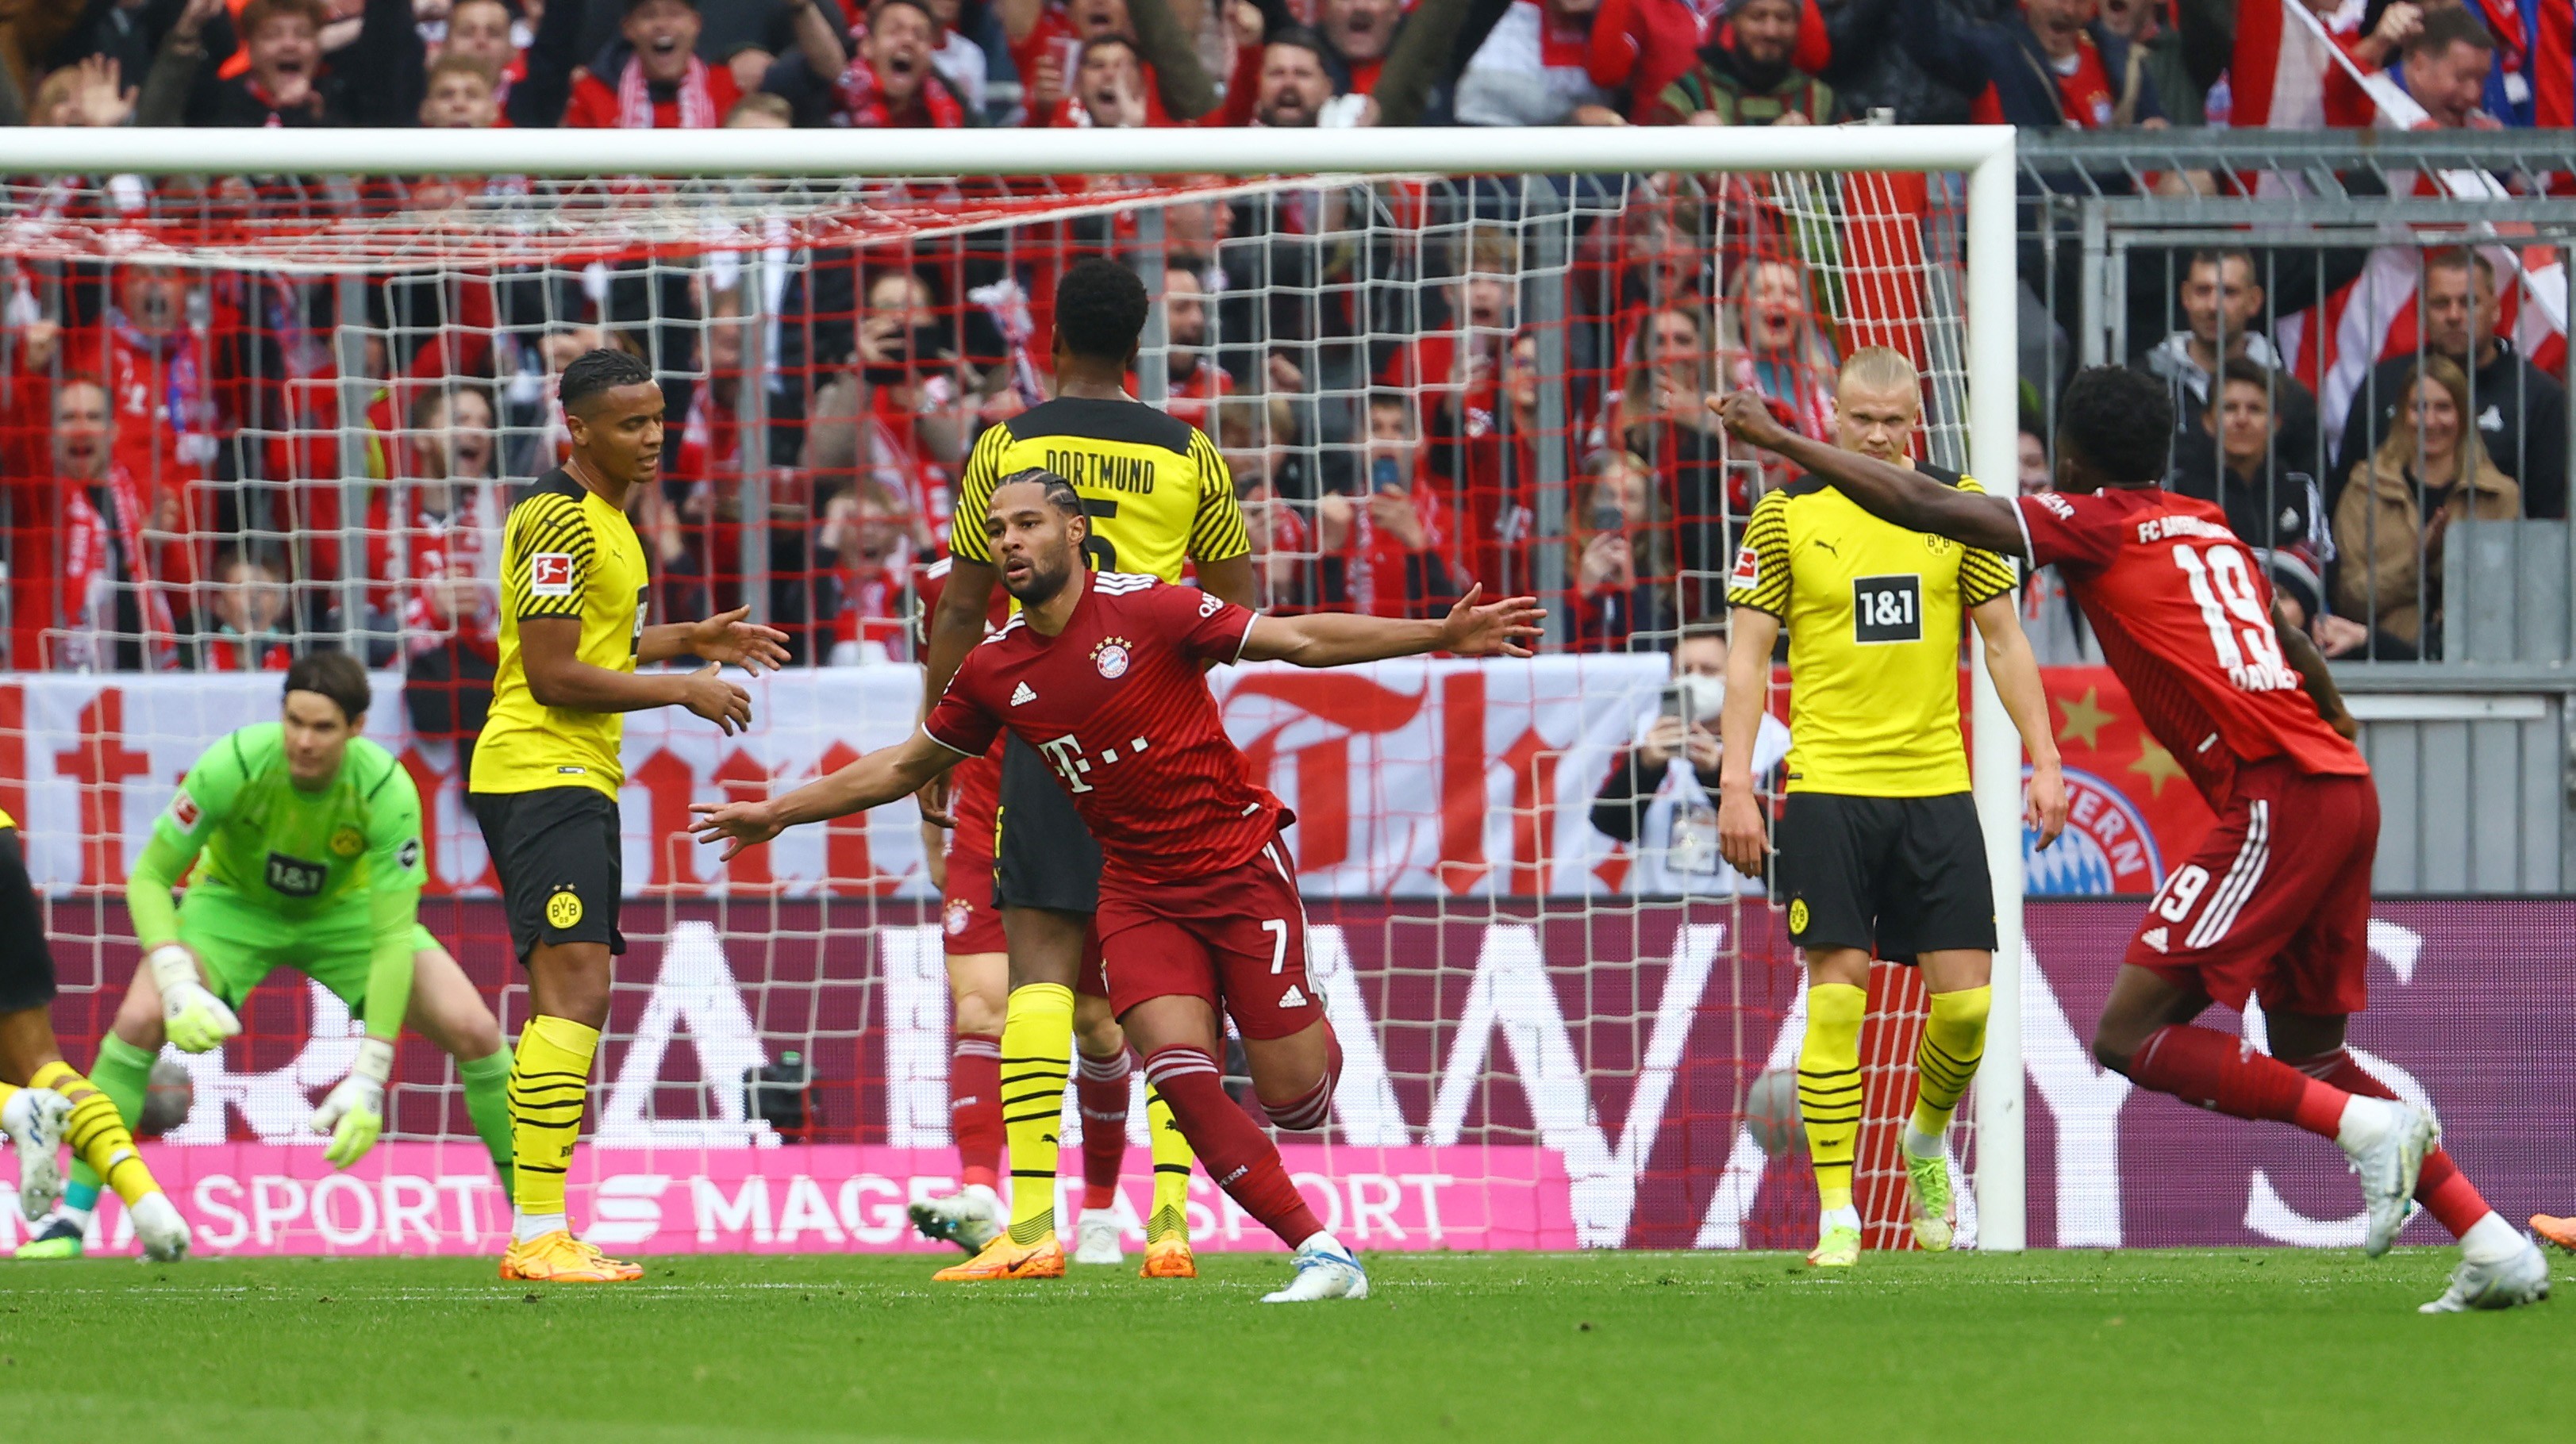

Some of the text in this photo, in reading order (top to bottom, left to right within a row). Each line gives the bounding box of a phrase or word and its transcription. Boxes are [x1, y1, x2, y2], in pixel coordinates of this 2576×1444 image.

[1045, 449, 1155, 494] DORTMUND
[2137, 520, 2161, 543] FC
[1859, 590, 1913, 626] 1&1
[2172, 544, 2283, 671] 19
[270, 861, 320, 891] 1&1
[552, 897, 578, 918] BVB
[1262, 919, 1287, 974] 7
[194, 1173, 490, 1248] SPORT
